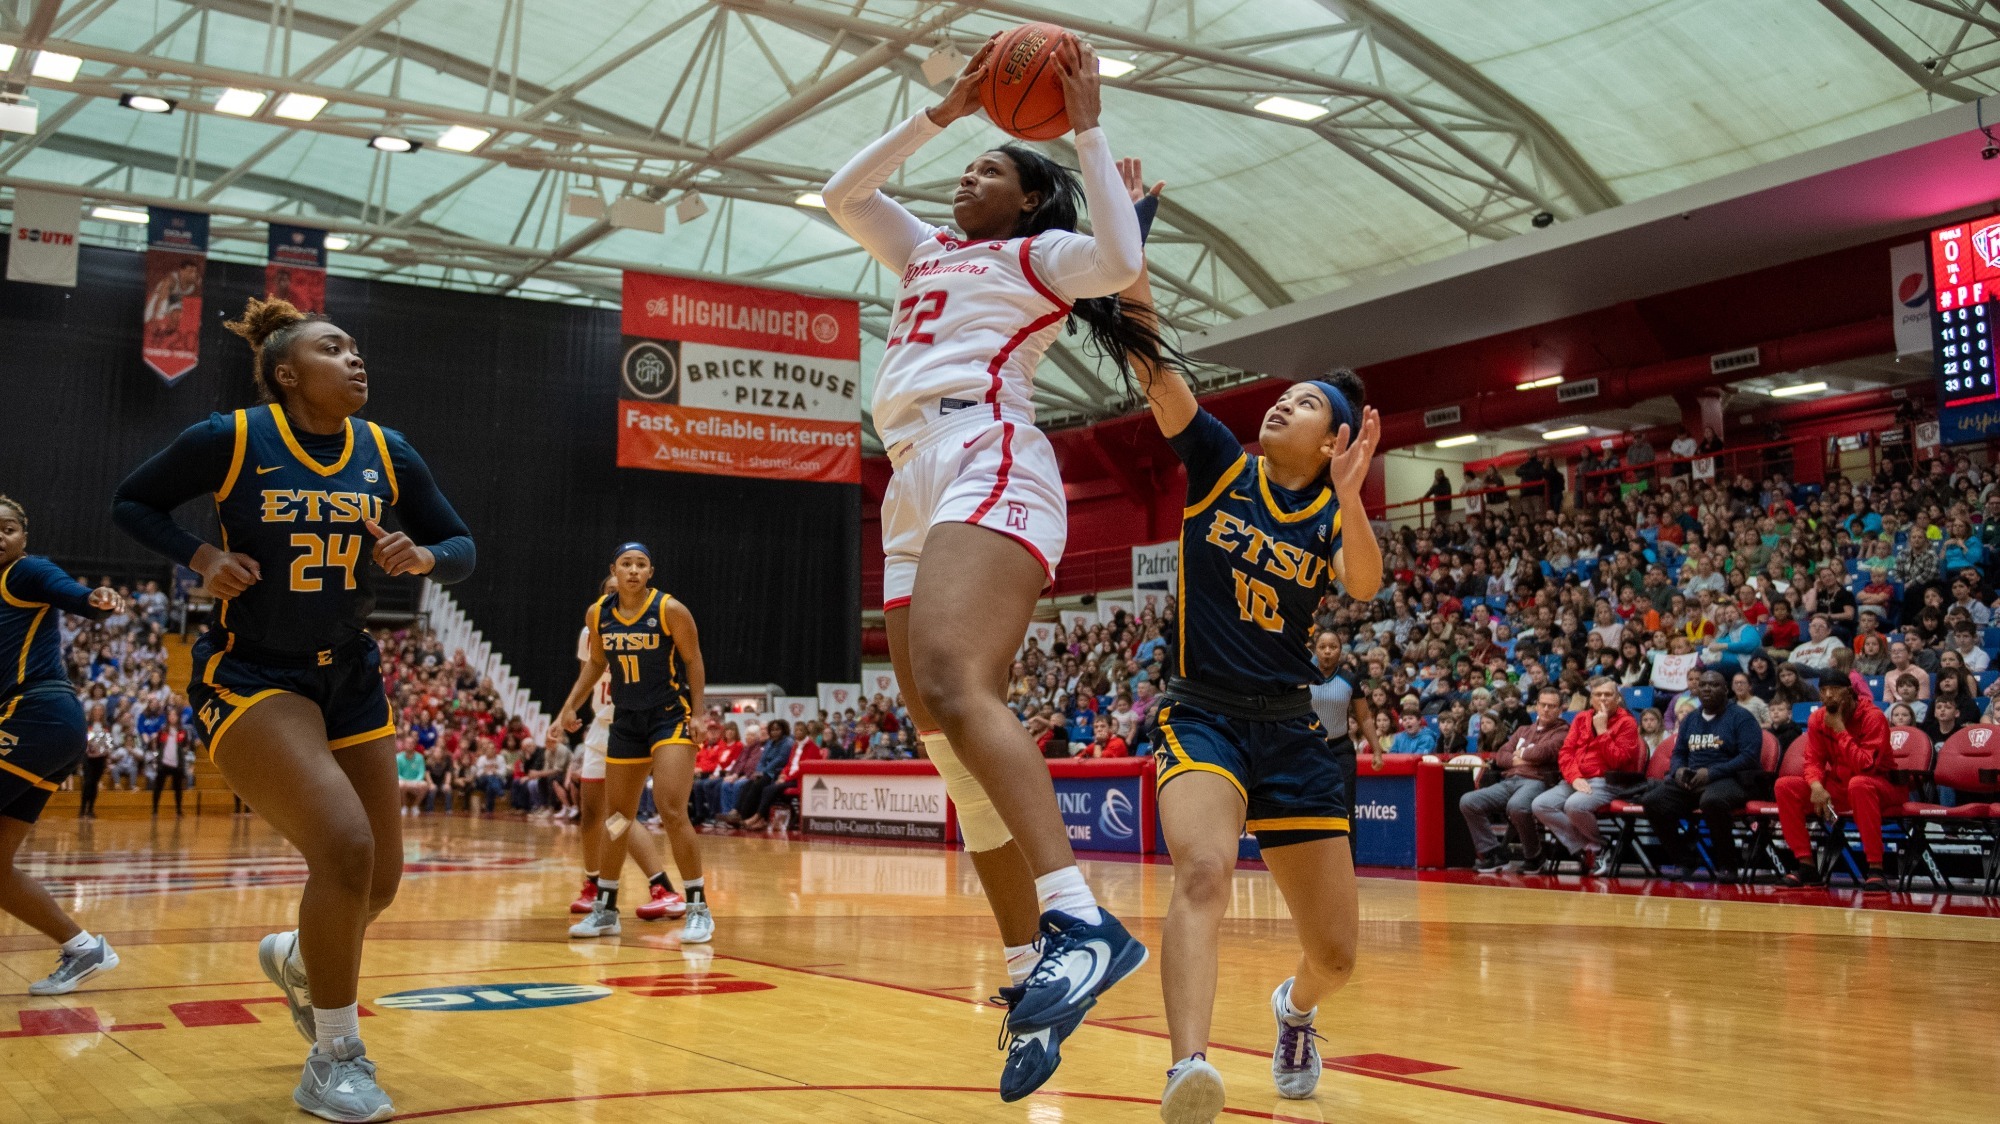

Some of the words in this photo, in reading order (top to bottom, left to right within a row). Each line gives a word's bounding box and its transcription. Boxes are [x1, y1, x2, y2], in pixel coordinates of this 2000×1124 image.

[1945, 241, 1959, 262] 0
[1958, 286, 1968, 306] P
[1973, 282, 1983, 302] F
[672, 294, 808, 341] HIGHLANDER
[887, 290, 949, 350] 22
[1942, 311, 1951, 323] 5
[1959, 308, 1967, 320] 0
[1975, 304, 1985, 317] 0
[1941, 327, 1955, 340] 11
[1960, 325, 1969, 338] 0
[1977, 321, 1987, 334] 0
[1943, 344, 1957, 358] 15
[1961, 342, 1970, 354] 0
[1978, 338, 1988, 351] 0
[1944, 361, 1958, 375] 22
[1963, 359, 1972, 372] 0
[1980, 356, 1989, 368] 0
[687, 359, 764, 383] BRICK
[773, 362, 856, 399] HOUSE
[1945, 378, 1960, 392] 33
[1965, 376, 1974, 389] 0
[1981, 373, 1991, 386] 0
[735, 386, 807, 411] PIZZA
[626, 409, 680, 435] Fast,
[686, 416, 765, 441] reliable
[770, 422, 856, 448] internet
[671, 448, 733, 464] SHENTEL
[749, 455, 820, 471] shentel.com
[260, 488, 383, 525] ETSU
[1006, 501, 1028, 531] R
[1205, 509, 1327, 589] ETSU
[290, 533, 362, 592] 24
[1232, 567, 1285, 633] 10
[601, 632, 660, 650] ETSU
[618, 655, 640, 684] 11
[834, 819, 875, 834] OFF-CAMPUS
[875, 821, 906, 836] STUDENT
[906, 823, 940, 838] HOUSING
